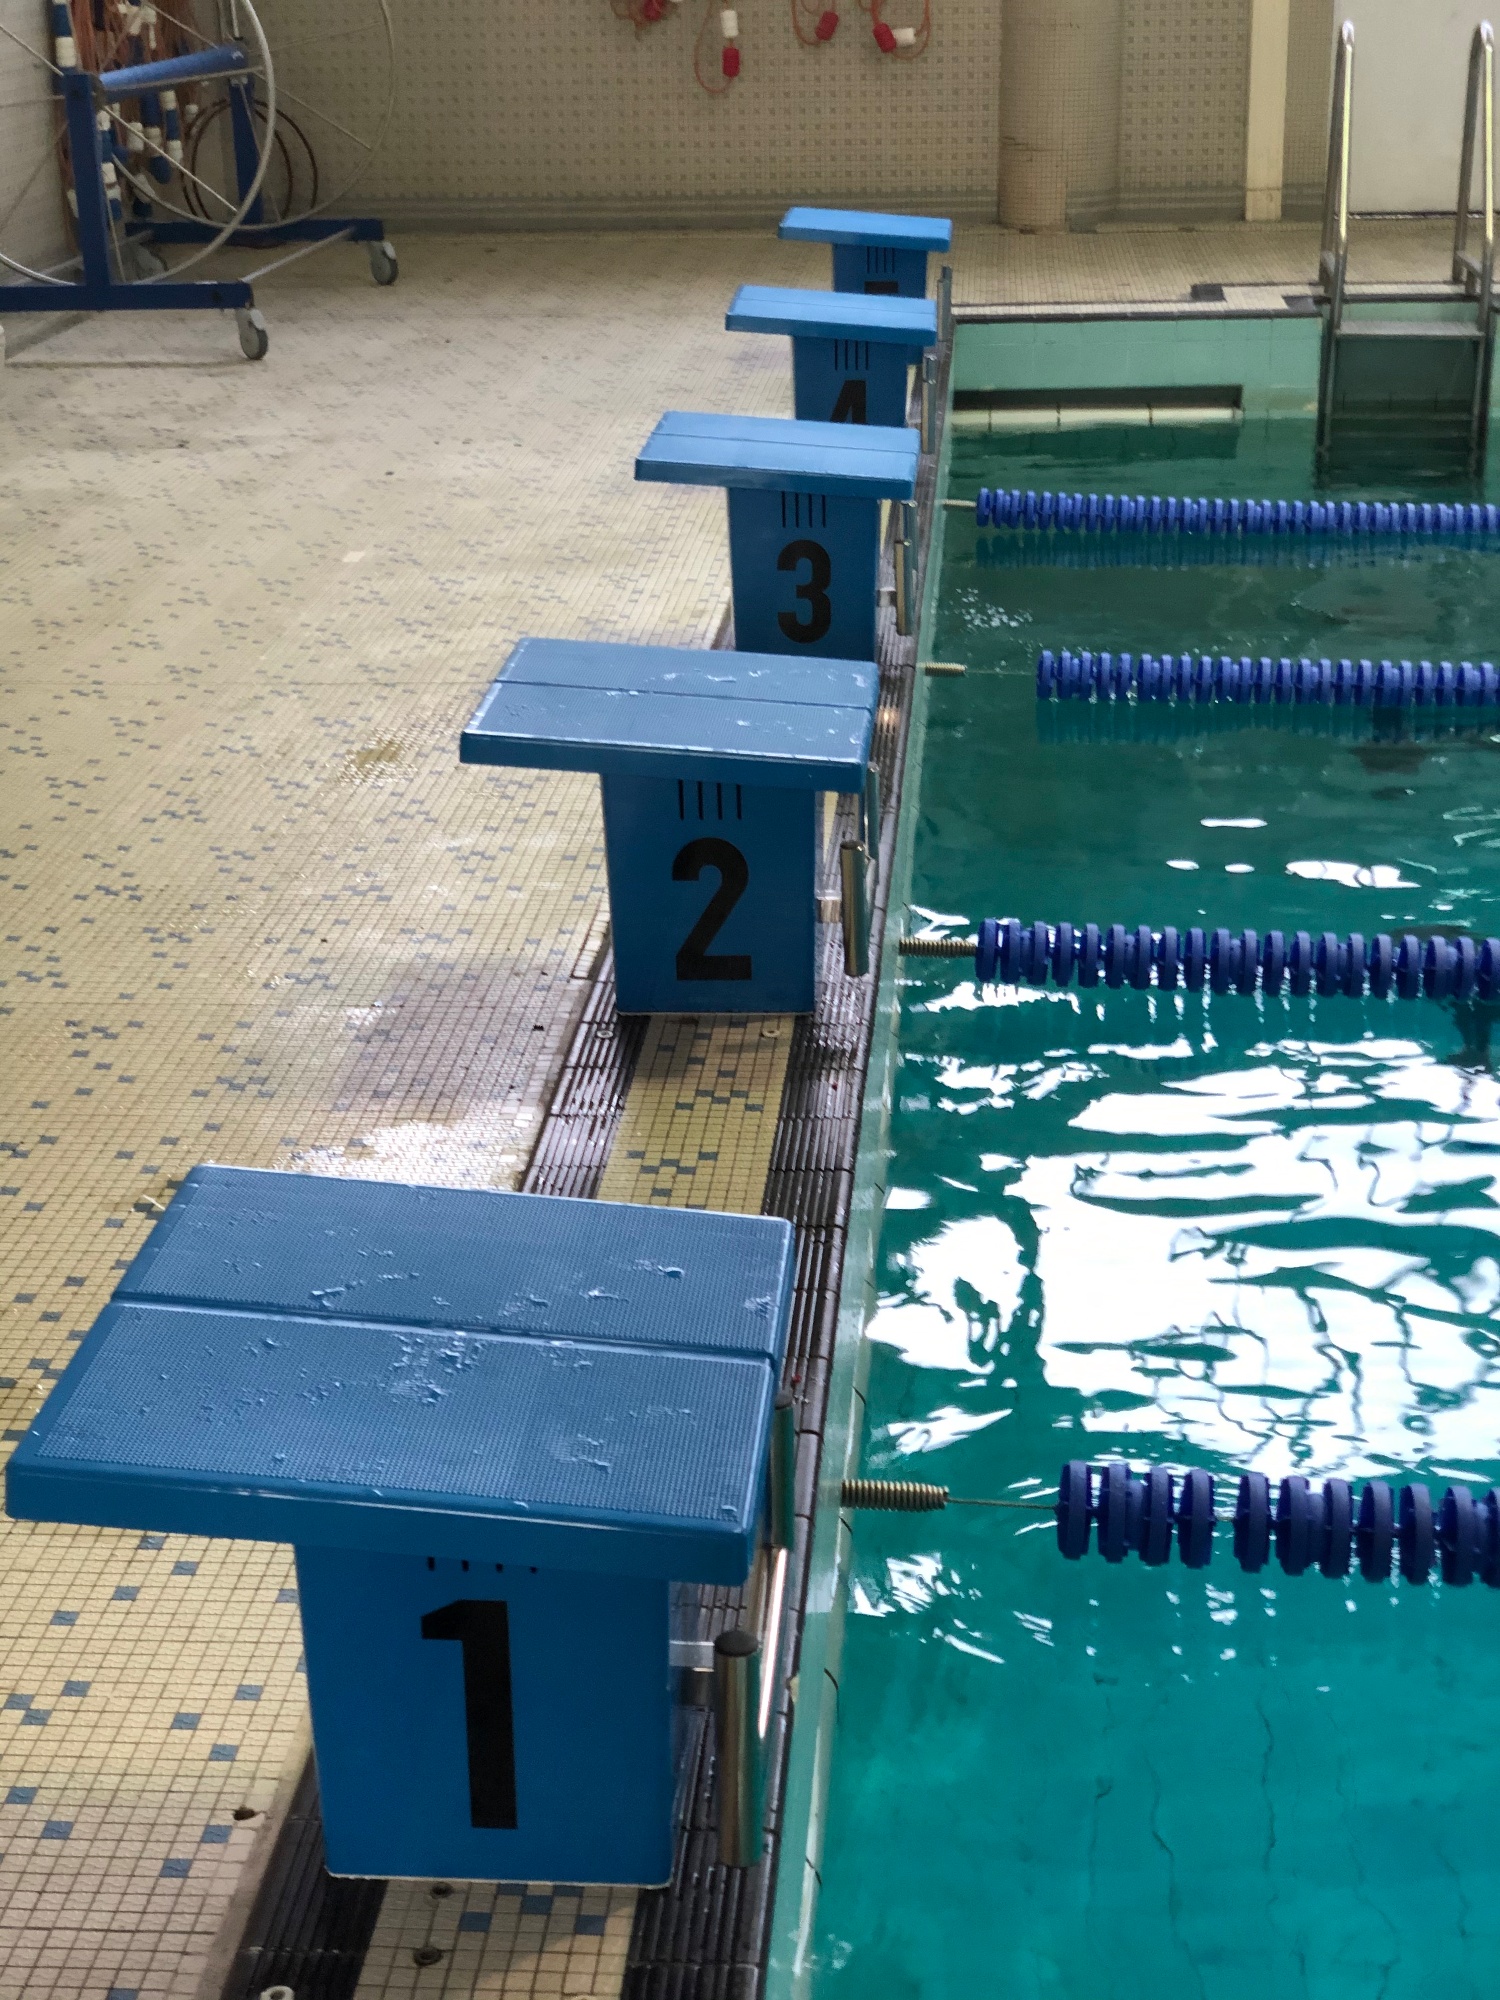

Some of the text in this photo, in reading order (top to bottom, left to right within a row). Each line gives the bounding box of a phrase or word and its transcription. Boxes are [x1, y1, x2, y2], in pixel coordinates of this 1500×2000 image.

[777, 539, 831, 643] 3
[672, 837, 752, 981] 2
[421, 1600, 518, 1829] 1
